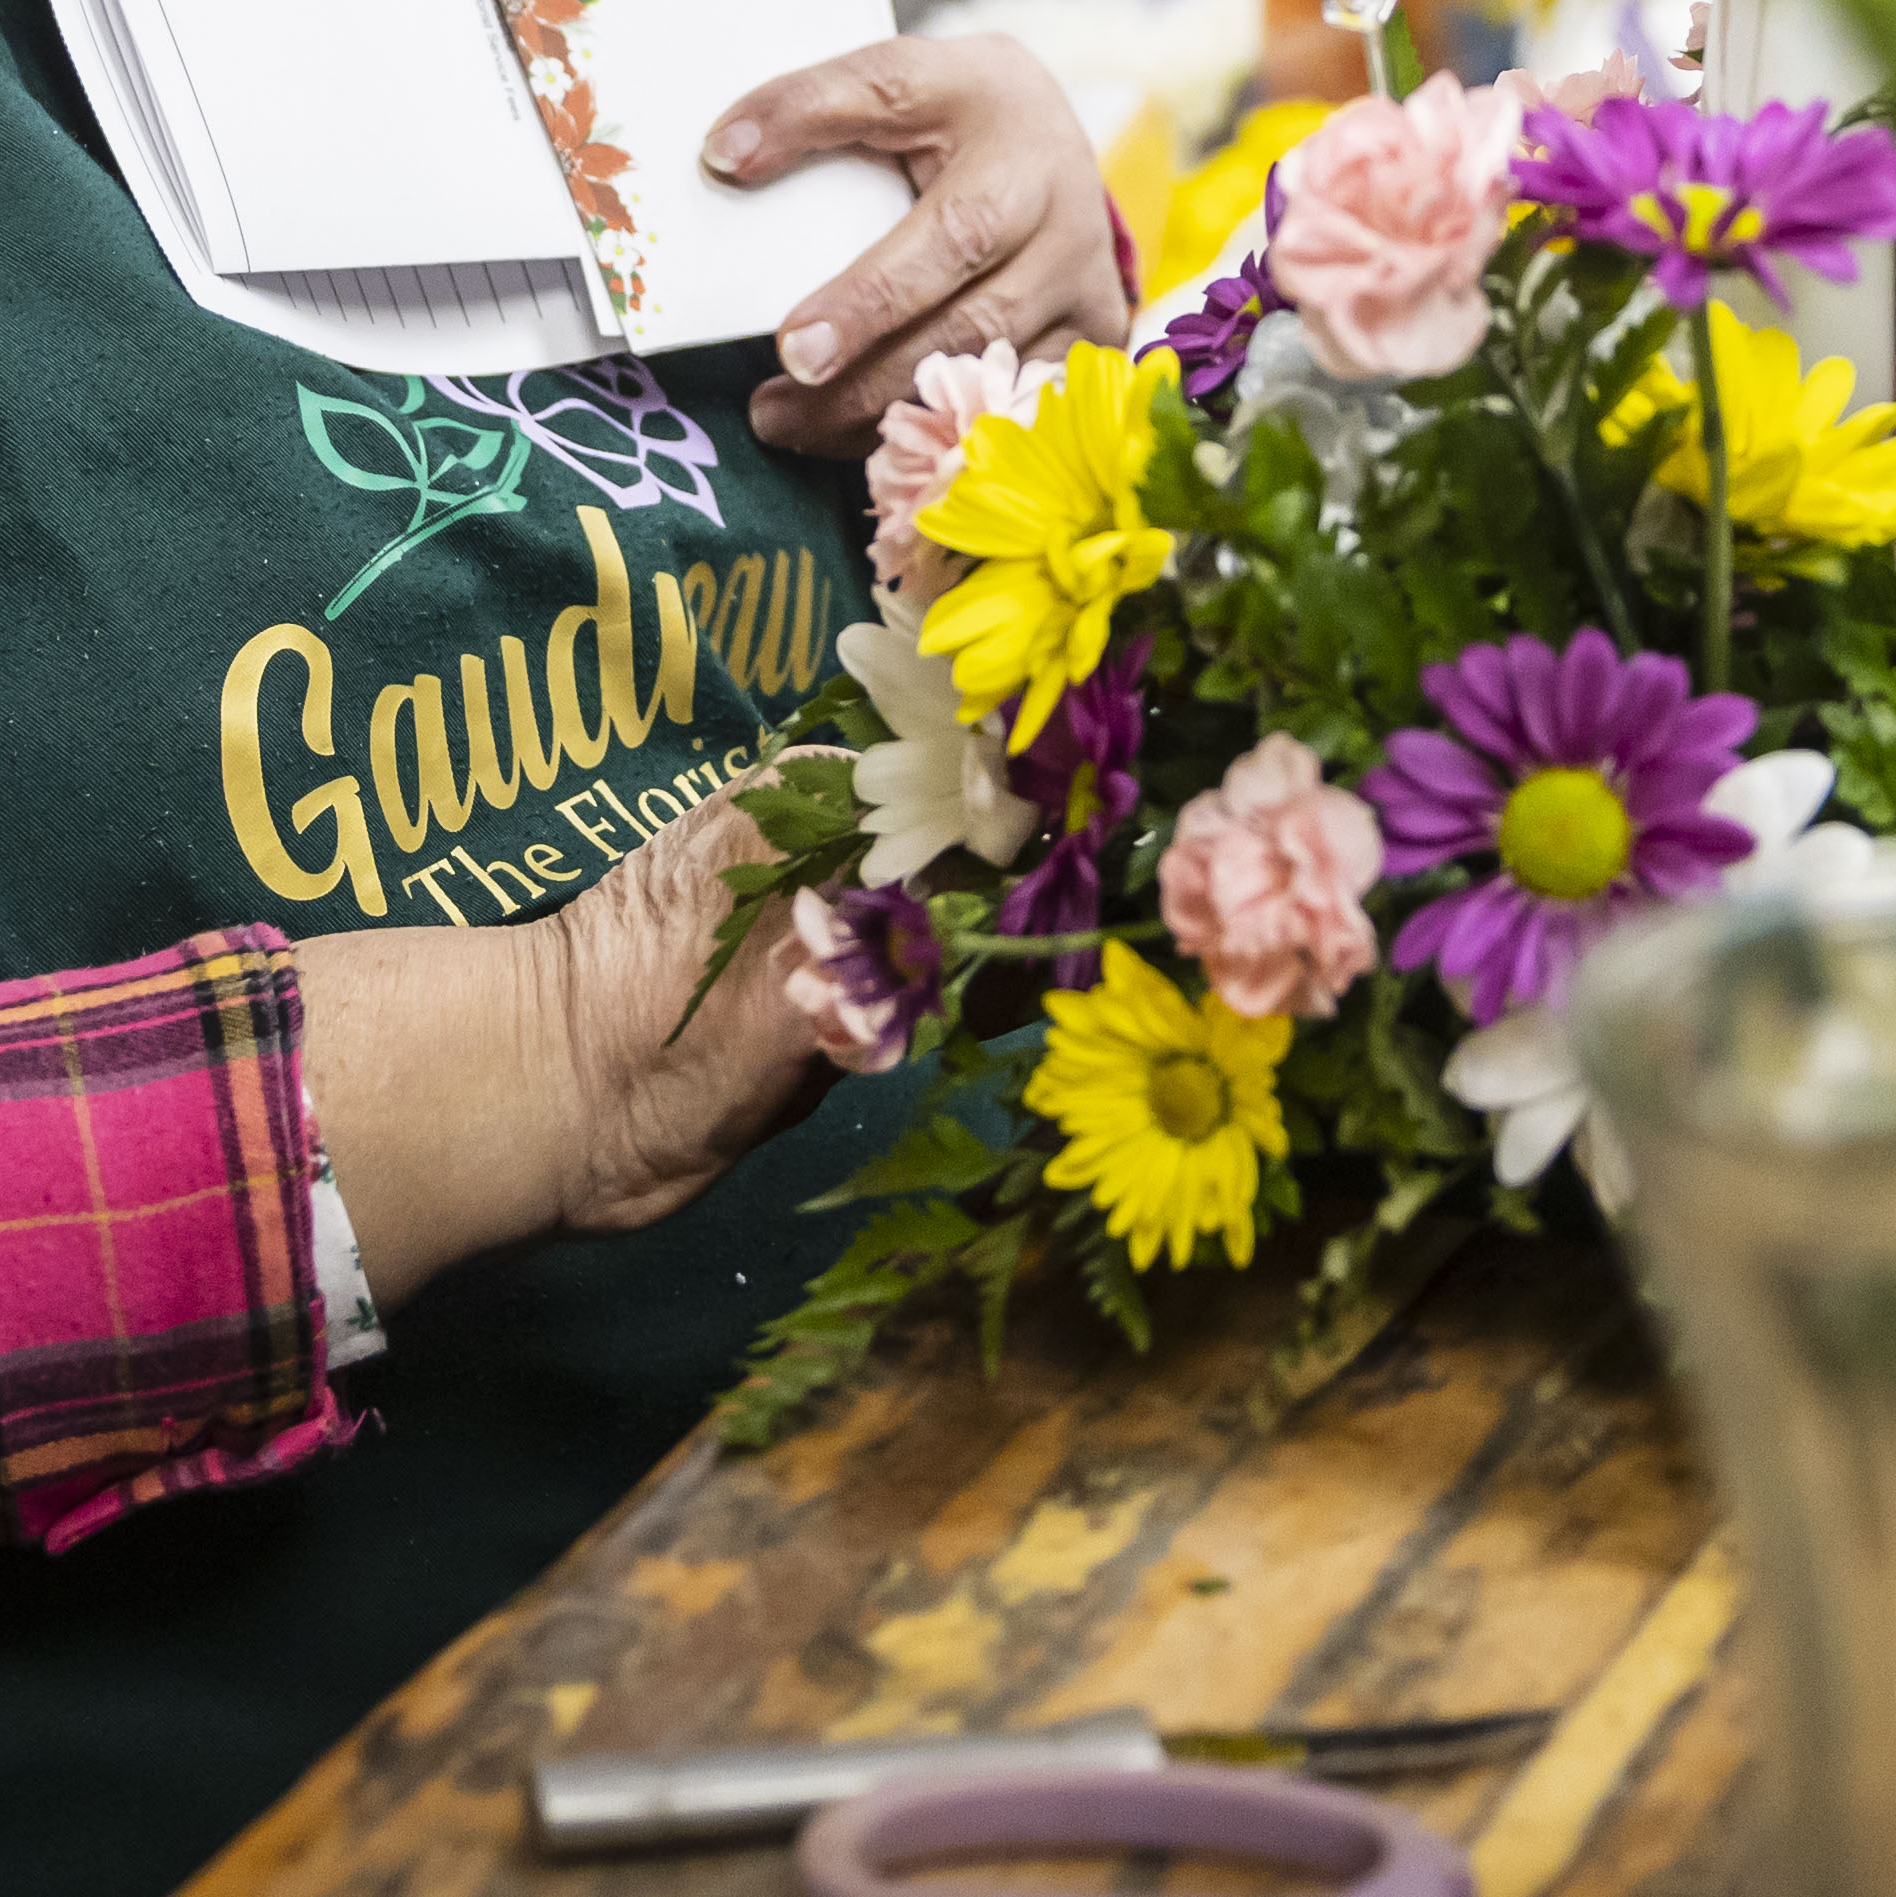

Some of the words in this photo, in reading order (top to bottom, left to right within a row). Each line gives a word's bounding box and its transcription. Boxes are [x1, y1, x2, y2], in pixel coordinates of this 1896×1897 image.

[487, 33, 509, 82] Service
[221, 505, 831, 917] Gaudrau
[401, 844, 582, 927] The
